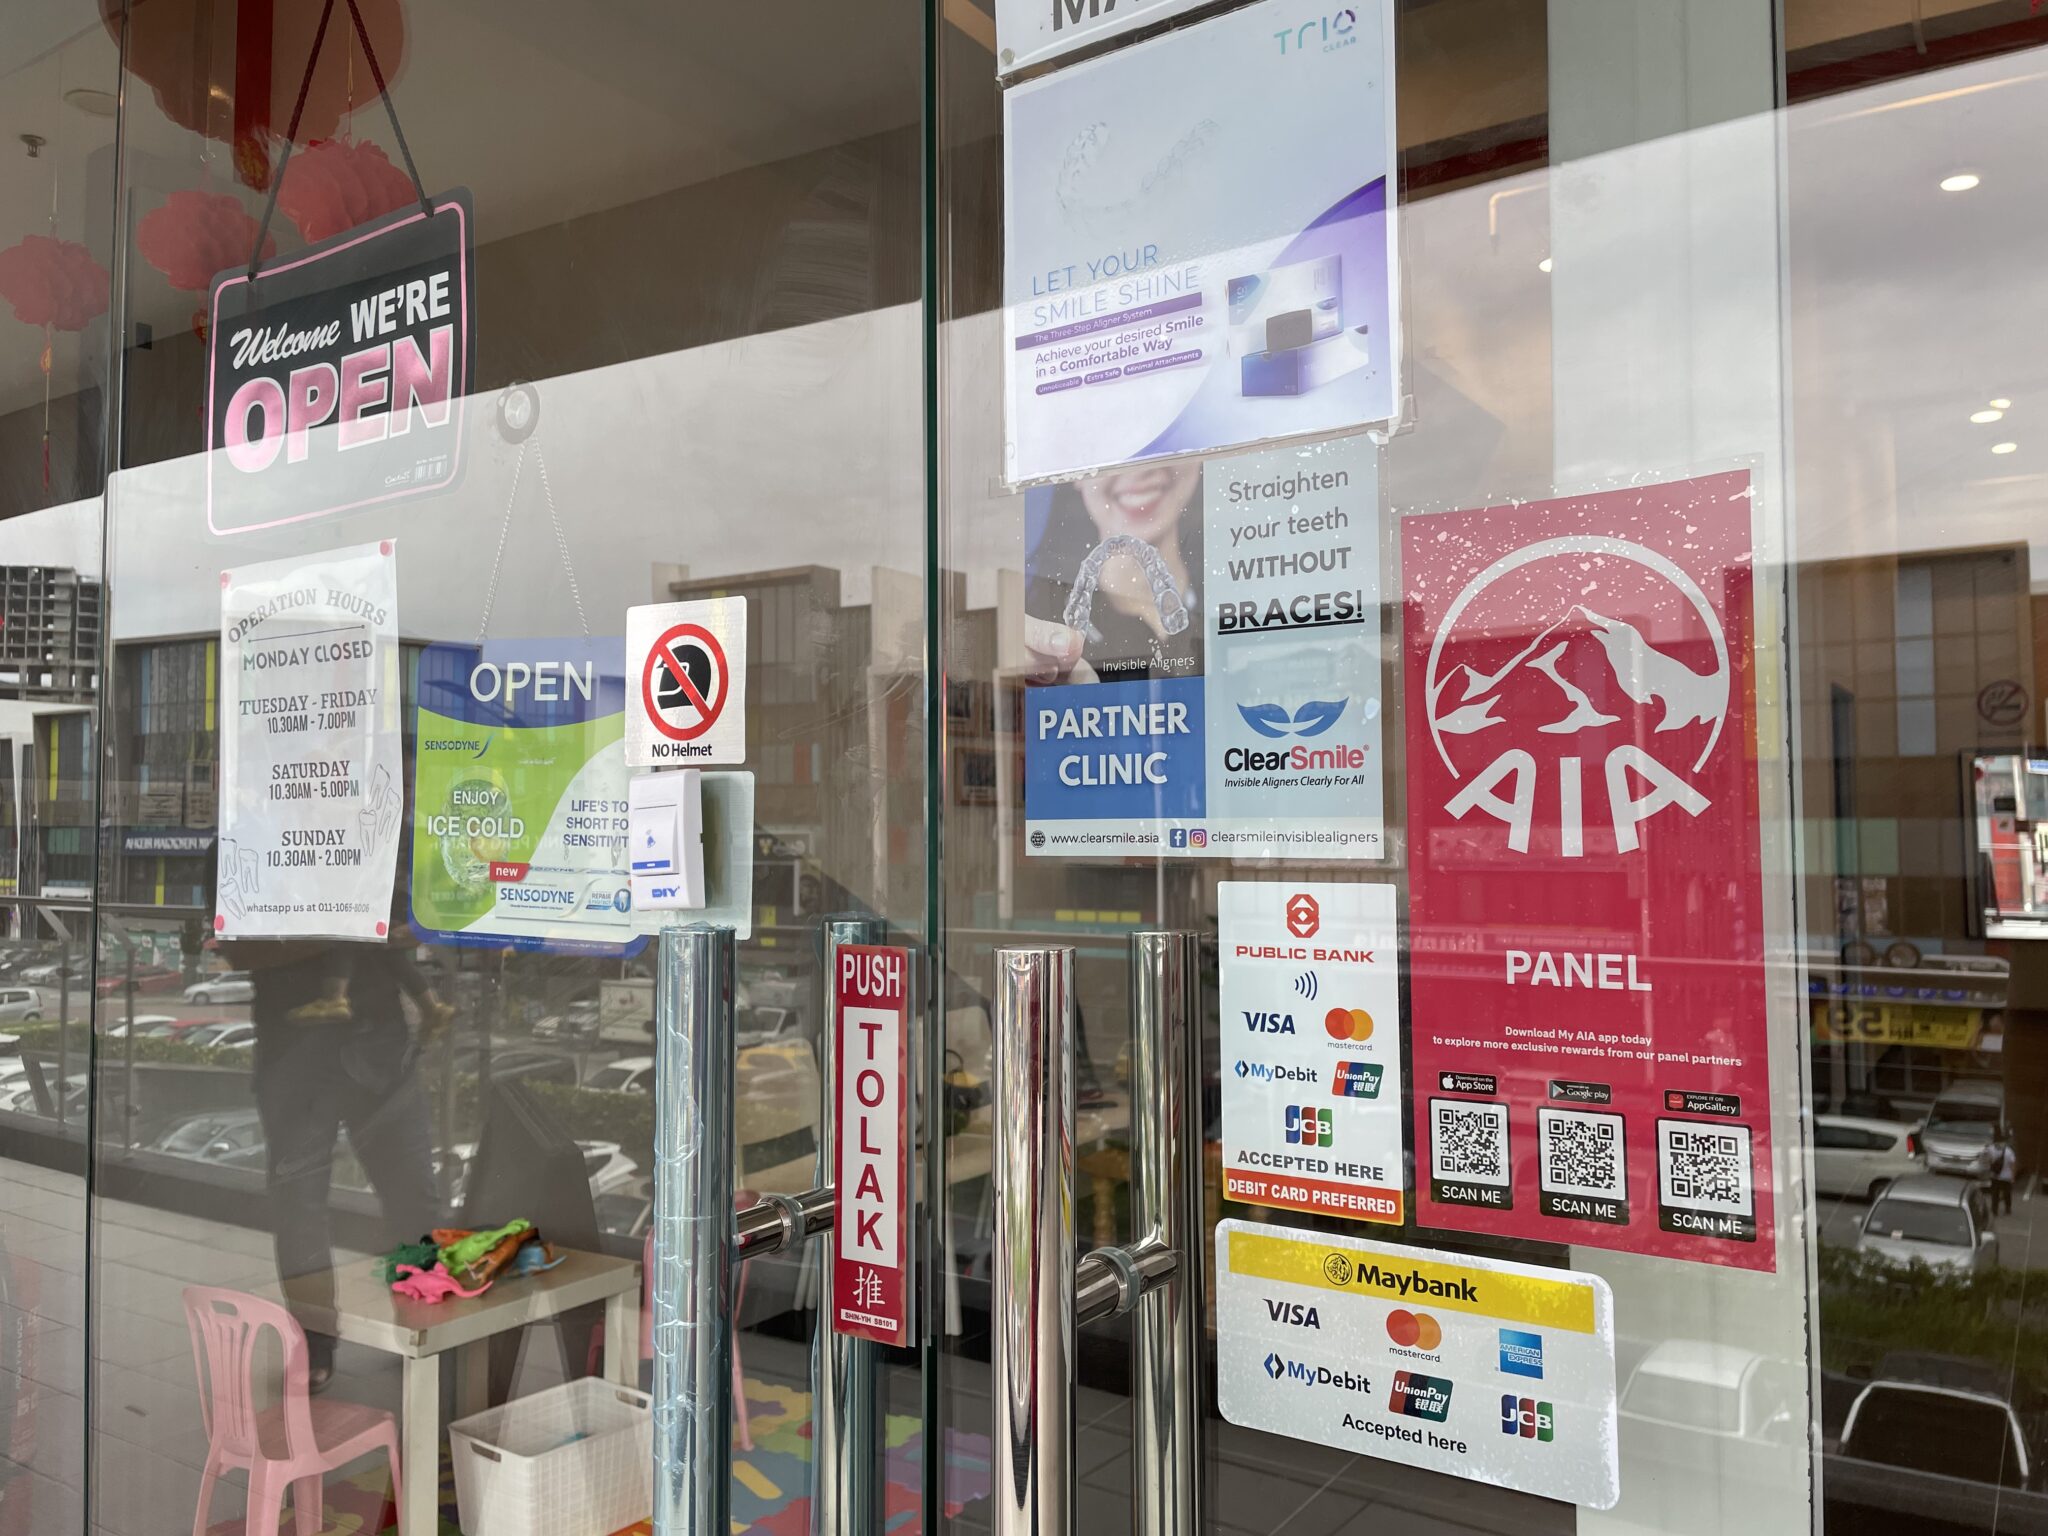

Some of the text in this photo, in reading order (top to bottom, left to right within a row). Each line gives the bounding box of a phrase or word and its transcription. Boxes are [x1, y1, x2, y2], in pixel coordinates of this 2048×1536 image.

[1323, 36, 1357, 53] CLEAR
[1033, 244, 1159, 297] LET YOUR
[1034, 266, 1200, 328] SMILE SHINE
[230, 319, 341, 369] Welcome
[350, 271, 451, 343] WE'RE
[1035, 309, 1152, 343] The Three-Step Aligner System
[1035, 315, 1204, 365] Achieve your desired Smile
[1036, 338, 1173, 378] in a Comfortable Way
[1038, 352, 1199, 393] Unnoticeable Extra Safe Minimal Attachments
[224, 323, 454, 473] OPEN
[1228, 468, 1349, 503] Straighten
[1229, 506, 1349, 547] your teeth
[1228, 547, 1352, 581] WITHOUT
[228, 588, 387, 643] OPERATION HOURS
[1218, 590, 1364, 631] BRACES!
[243, 640, 373, 671] MONDAY CLOSED
[1102, 654, 1195, 673] Invisible Aligners
[470, 661, 593, 702] OPEN
[240, 694, 308, 716] TUESDAY
[321, 688, 377, 709] FRIDAY
[267, 715, 308, 734] 10.30AM
[317, 711, 356, 730] 7.00PM
[1039, 701, 1190, 740] PARTNER
[424, 740, 480, 751] SENSODYNE
[652, 743, 713, 758] NO Helmet
[1224, 744, 1365, 771] ClearSmile
[272, 760, 350, 780] SATURDAY
[1058, 752, 1168, 786] CLINIC
[269, 782, 312, 800] 10.30AM
[320, 780, 359, 798] 5.00PM
[1224, 774, 1364, 789] Invisible Aligners Clearly For All
[453, 791, 498, 805] ENJOY
[571, 800, 629, 813] LIFE'S TO
[1443, 744, 1712, 857] AIA
[427, 815, 524, 838] ICE COLD
[566, 817, 629, 831] SHORT FO
[281, 829, 345, 847] SUNDAY
[563, 834, 629, 848] SENSITIVIT
[1050, 830, 1378, 846] www.clearsmile.asia clearsmileinvisiblealigners
[266, 850, 316, 867] 10.30AM
[325, 849, 361, 866] 2.00PM
[496, 867, 518, 877] new
[500, 888, 575, 904] SENSODYNE
[247, 903, 290, 914] whatsapp
[293, 904, 304, 912] us
[306, 903, 316, 912] at
[1236, 945, 1375, 964] PUBLIC BANK
[842, 953, 900, 998] PUSH
[1505, 949, 1652, 992] PANEL
[1241, 1011, 1296, 1035] VISA
[1327, 1041, 1373, 1051] mastercard
[1505, 1026, 1652, 1047] Download My AIA app today
[1432, 1036, 1742, 1067] to explore more exclusive rewards from our panel partners
[1251, 1063, 1318, 1083] MyDebit
[1336, 1068, 1380, 1087] UnionPay
[1456, 1080, 1493, 1091] App Store
[1566, 1088, 1608, 1100] Google play
[1687, 1101, 1736, 1113] AppGallery
[855, 1022, 885, 1252] TOLAK
[1286, 1117, 1331, 1136] JCB
[1237, 1150, 1384, 1181] ACCEPTED HERE
[1228, 1178, 1396, 1215] DEBIT CARD PREFERRED
[1442, 1185, 1501, 1203] SCAN ME
[1552, 1198, 1616, 1218] SCAN ME
[1672, 1213, 1742, 1235] SCAN ME
[852, 1265, 885, 1310] 推
[1356, 1262, 1478, 1303] Maybank
[845, 1311, 892, 1328] SHIN-YIH SB101
[1262, 1298, 1320, 1330] VISA
[1389, 1347, 1440, 1363] mastercard
[1500, 1343, 1540, 1357] AMERICAN
[1509, 1354, 1543, 1366] EXPRESS
[1288, 1361, 1371, 1394] MyDebit
[1394, 1380, 1448, 1404] UnionPay
[1414, 1398, 1444, 1414] 银联
[1502, 1408, 1552, 1430] JCB
[1342, 1413, 1468, 1454] Accepted here
